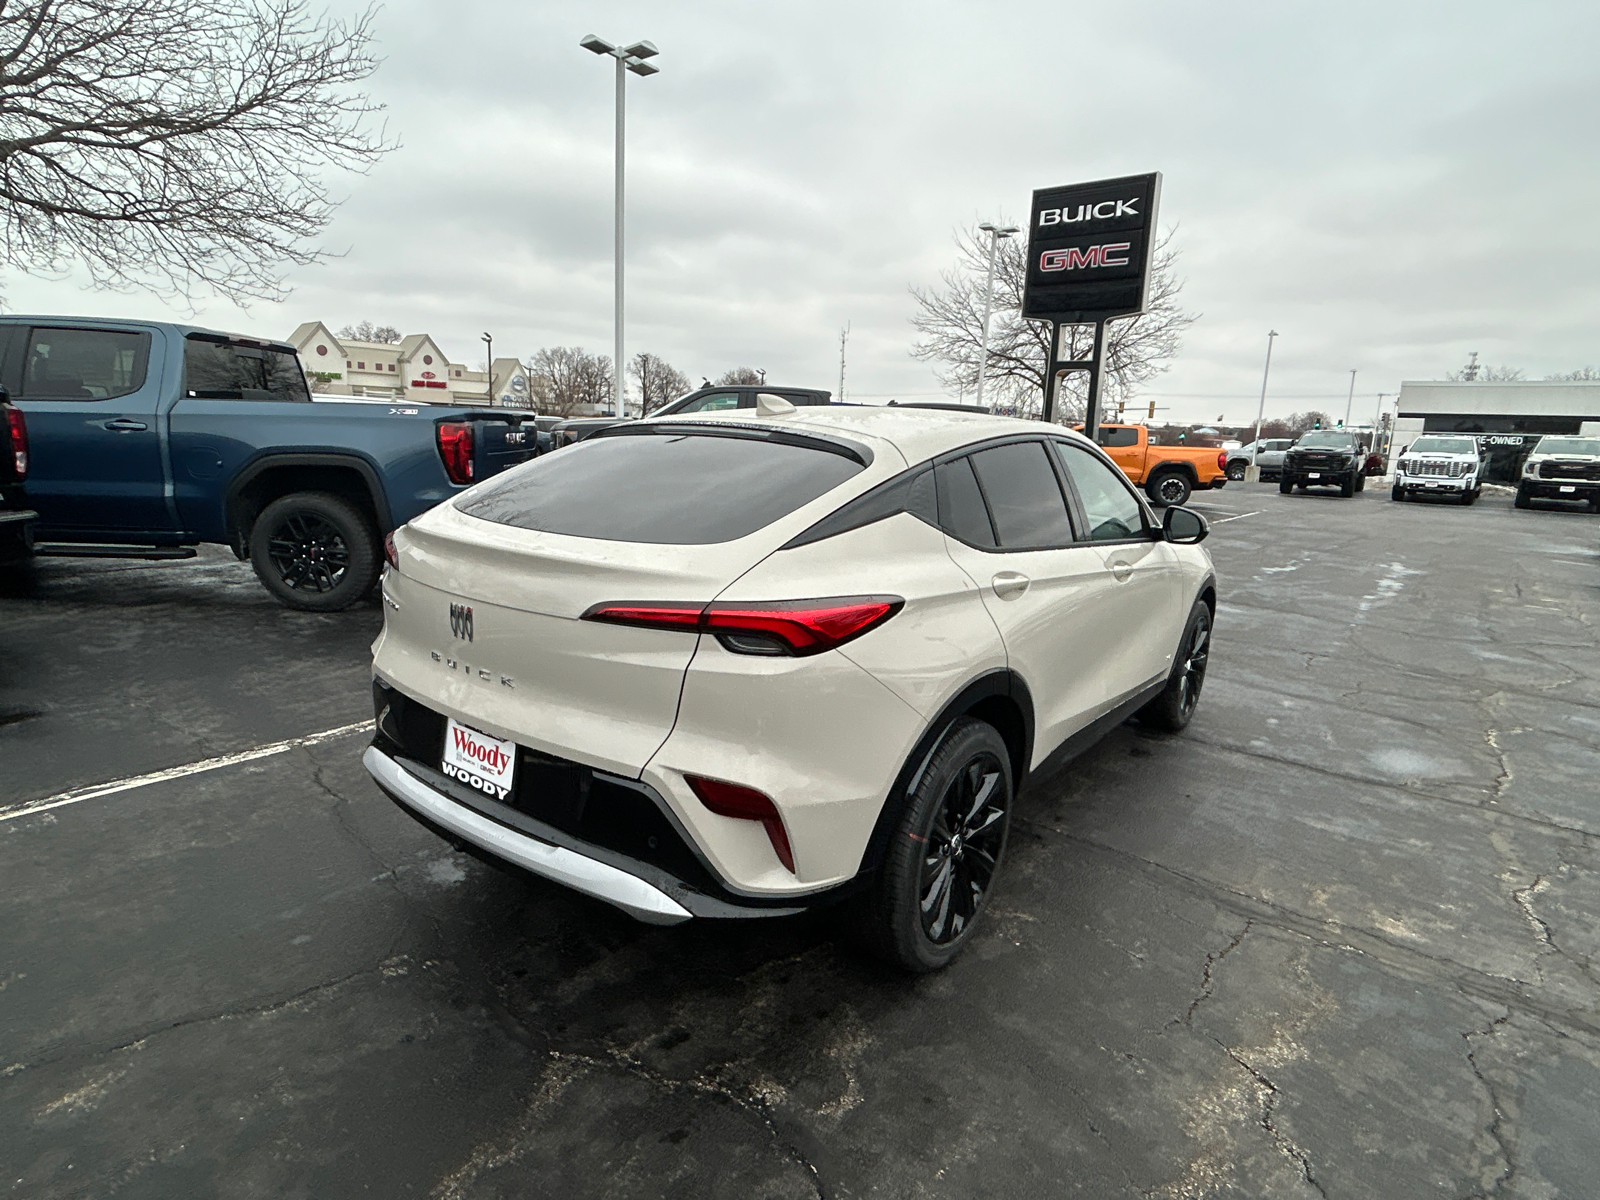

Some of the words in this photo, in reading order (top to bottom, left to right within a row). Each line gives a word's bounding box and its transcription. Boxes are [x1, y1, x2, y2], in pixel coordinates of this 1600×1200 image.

[1039, 197, 1140, 226] BUICK
[1040, 242, 1131, 273] GMC
[1475, 435, 1524, 446] RE-OWNED
[431, 651, 515, 690] BUICK
[452, 726, 511, 776] Woody
[441, 760, 510, 801] WOODY
[480, 764, 496, 776] GMC
